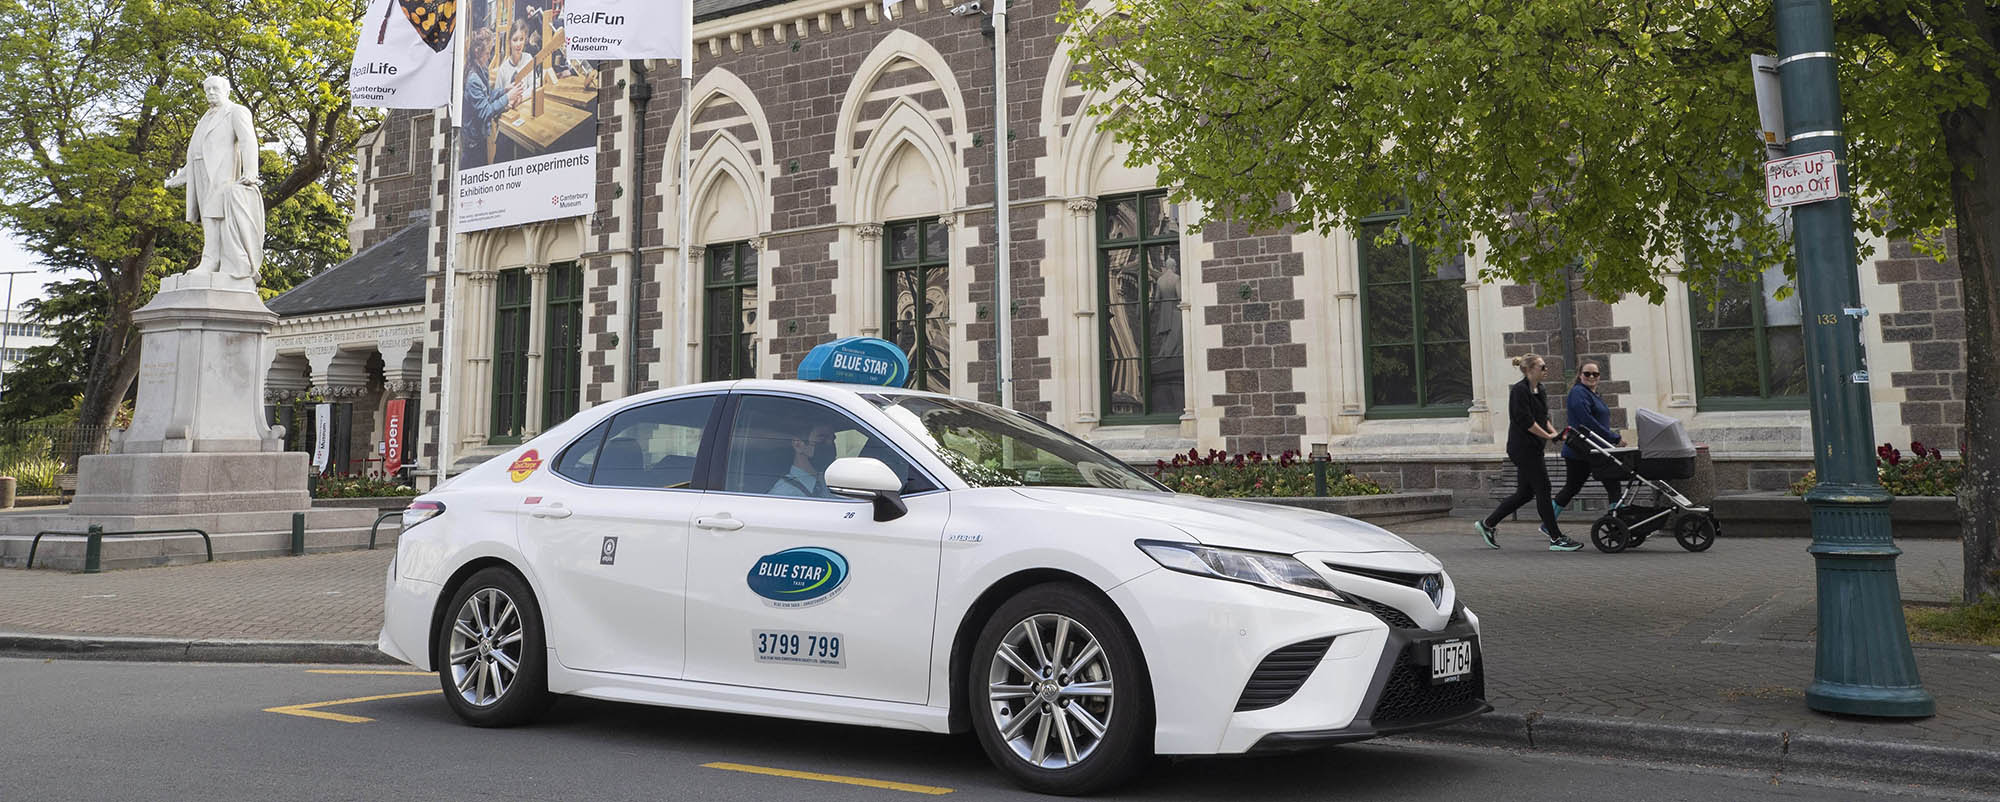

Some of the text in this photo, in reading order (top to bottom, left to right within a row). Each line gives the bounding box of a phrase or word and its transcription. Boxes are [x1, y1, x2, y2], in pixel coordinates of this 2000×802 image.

[566, 12, 624, 25] RealFun
[572, 36, 622, 46] Canterbury
[460, 154, 590, 186] Hands-on fun experiments
[1804, 160, 1823, 175] Up
[460, 180, 522, 198] Exhibition on now
[560, 192, 589, 201] Canterbury
[560, 200, 581, 208] Museum
[1817, 313, 1838, 325] 133
[834, 353, 862, 371] BLUE
[863, 358, 888, 375] STAR
[389, 417, 399, 458] open
[758, 562, 822, 580] BLUE STAR
[758, 633, 840, 658] 3799 799
[1433, 644, 1470, 675] LUF764
